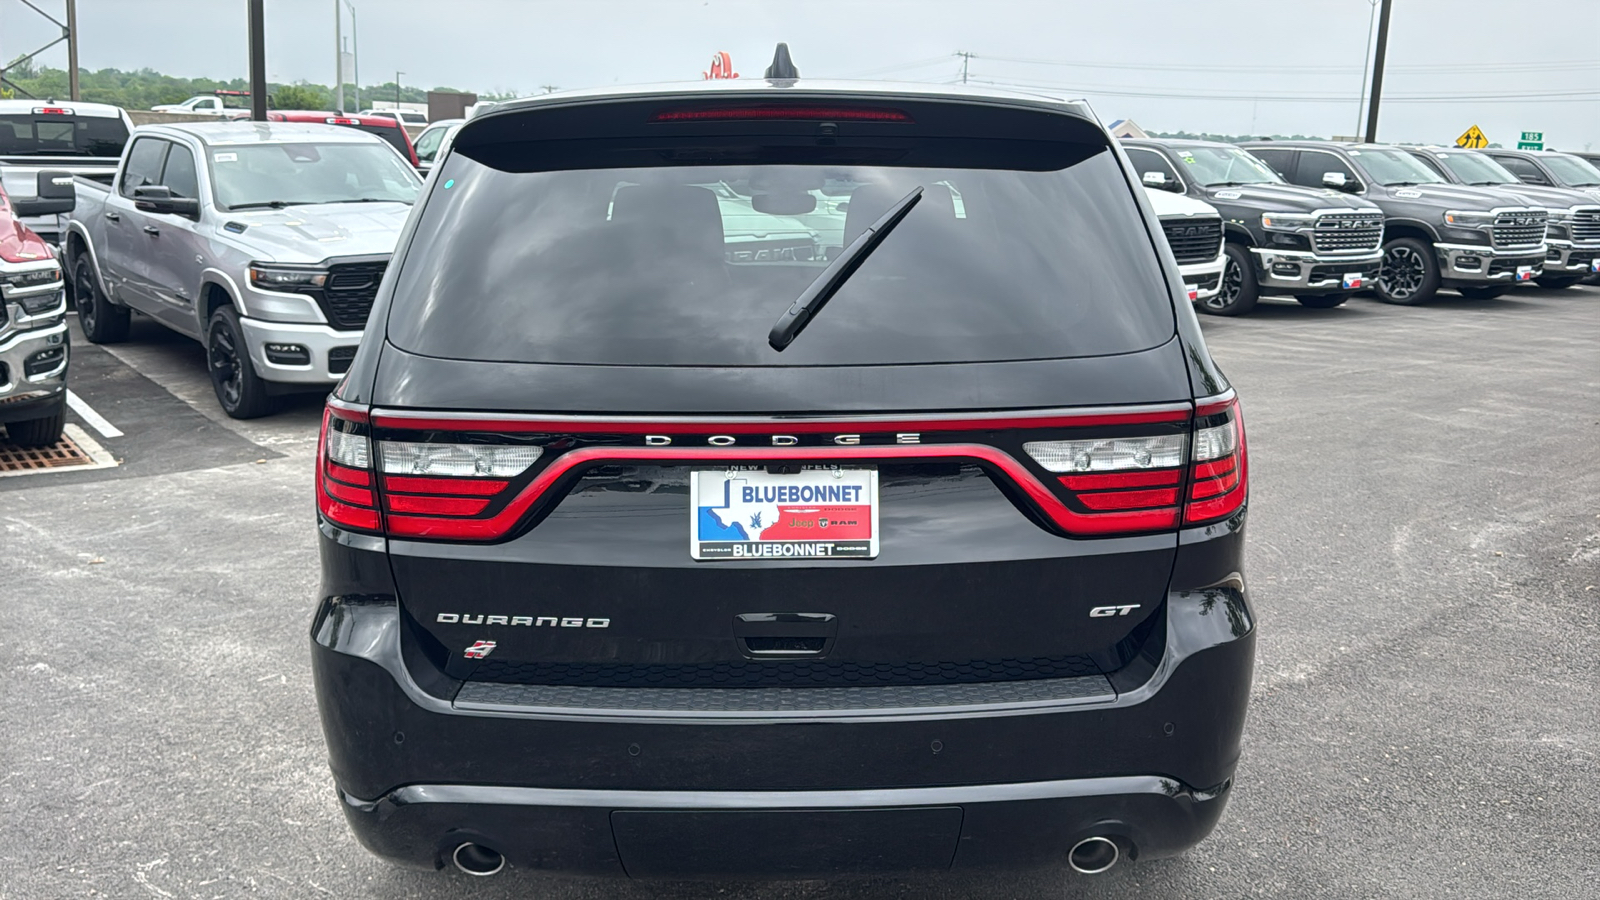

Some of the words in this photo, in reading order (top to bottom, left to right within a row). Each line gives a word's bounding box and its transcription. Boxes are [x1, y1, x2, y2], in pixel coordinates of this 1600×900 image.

[1171, 226, 1210, 236] RAM
[733, 247, 797, 261] RAM
[645, 433, 921, 446] DODGE
[742, 485, 862, 503] BLUEBONNET
[788, 518, 814, 528] Jeep
[733, 543, 835, 557] BLUEBONNET
[1089, 603, 1141, 617] GT
[436, 613, 611, 628] DURANGO
